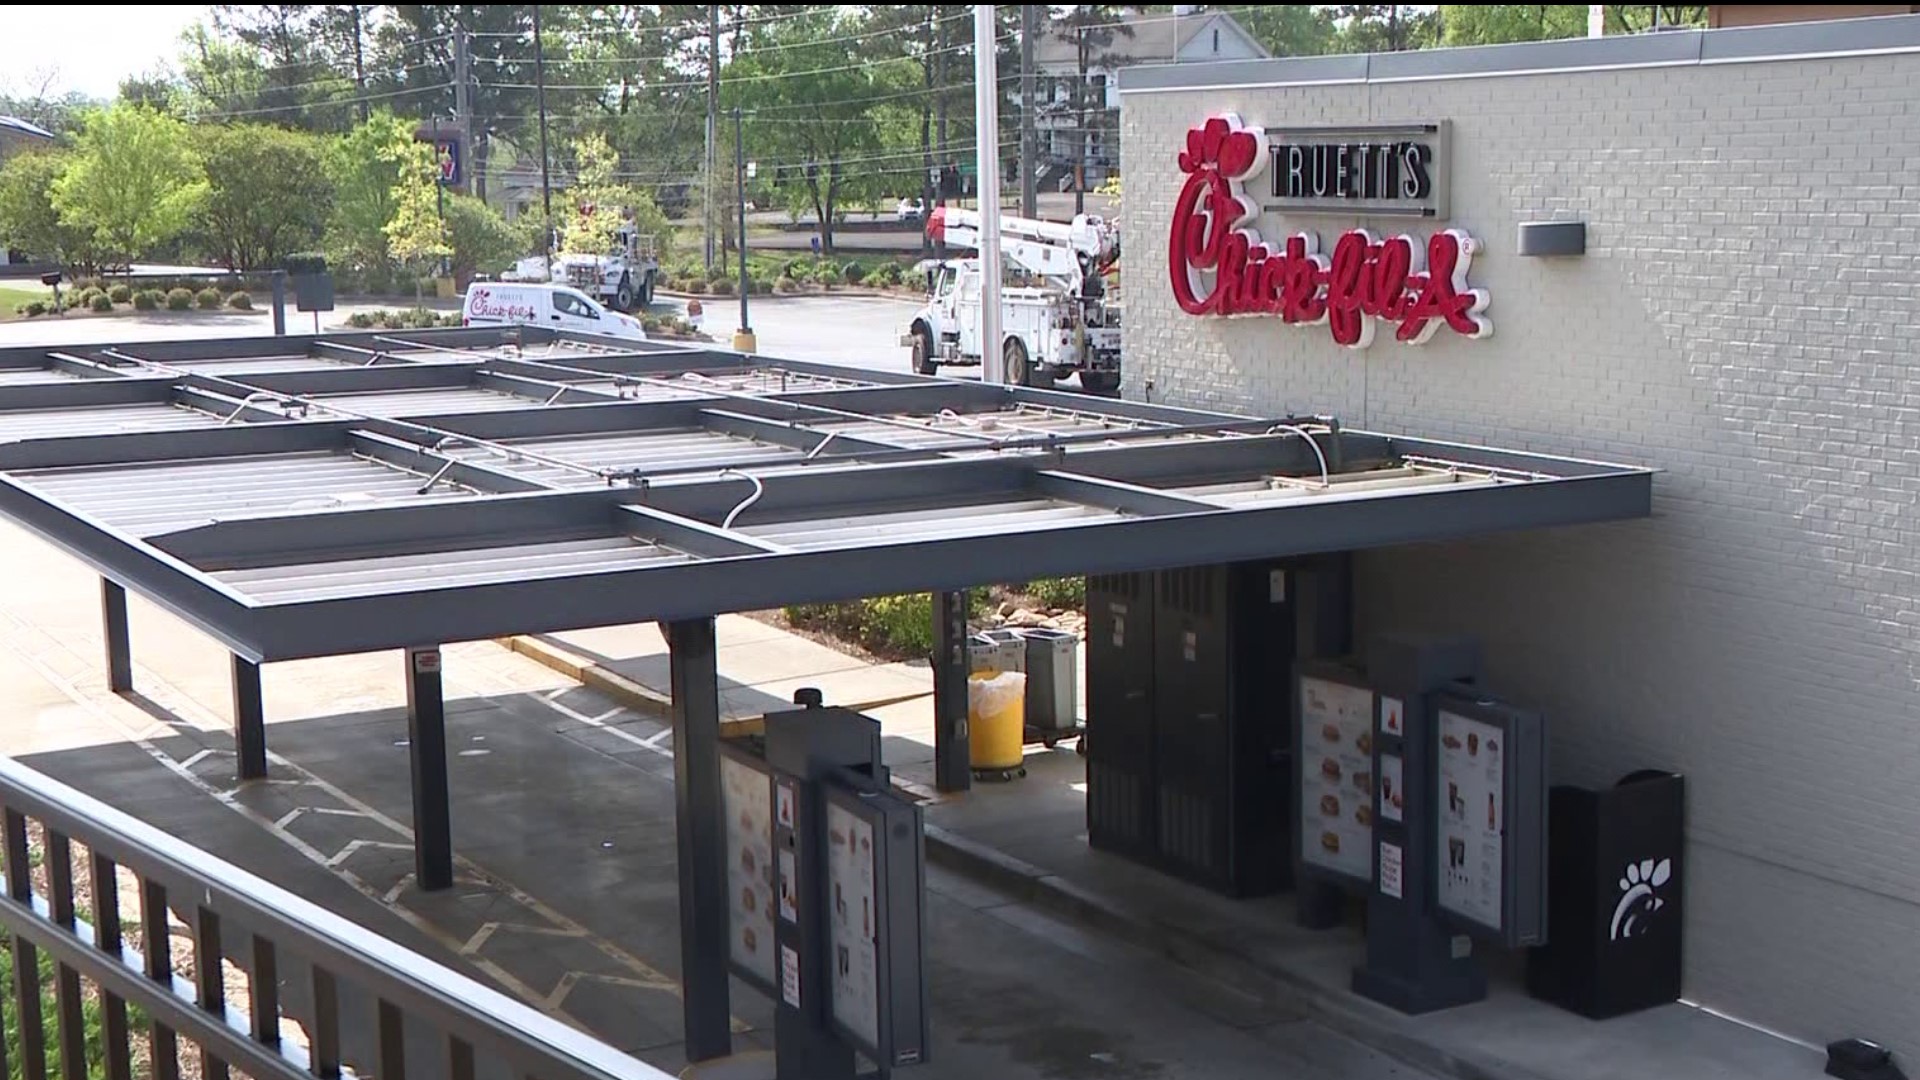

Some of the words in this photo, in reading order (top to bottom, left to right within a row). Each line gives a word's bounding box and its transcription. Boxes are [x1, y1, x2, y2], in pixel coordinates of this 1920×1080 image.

[1269, 141, 1432, 198] TRUETT'S
[1169, 160, 1490, 347] Chick-fil-A
[471, 295, 536, 320] Chick-fil-A
